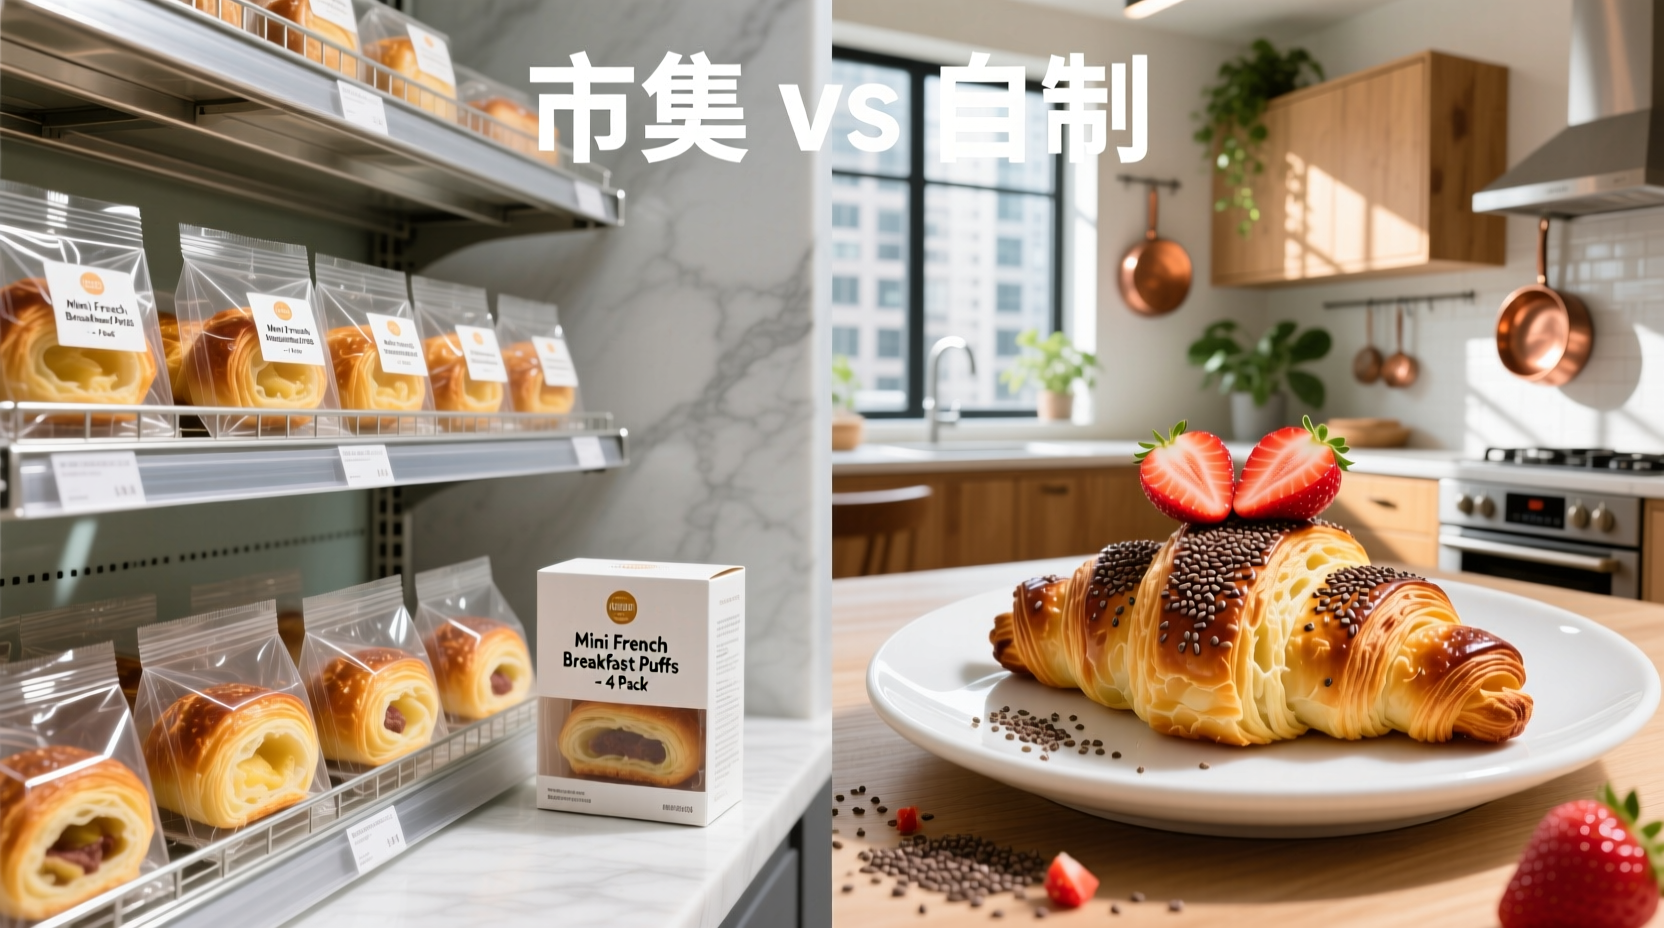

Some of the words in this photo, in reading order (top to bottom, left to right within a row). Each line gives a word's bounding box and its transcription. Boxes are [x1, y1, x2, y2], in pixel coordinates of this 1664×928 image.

[575, 631, 608, 650] Mini
[613, 634, 668, 653] French
[563, 651, 636, 672] Breakfast
[639, 656, 679, 674] Puffs
[605, 675, 615, 690] 4
[618, 675, 649, 692] Pack
